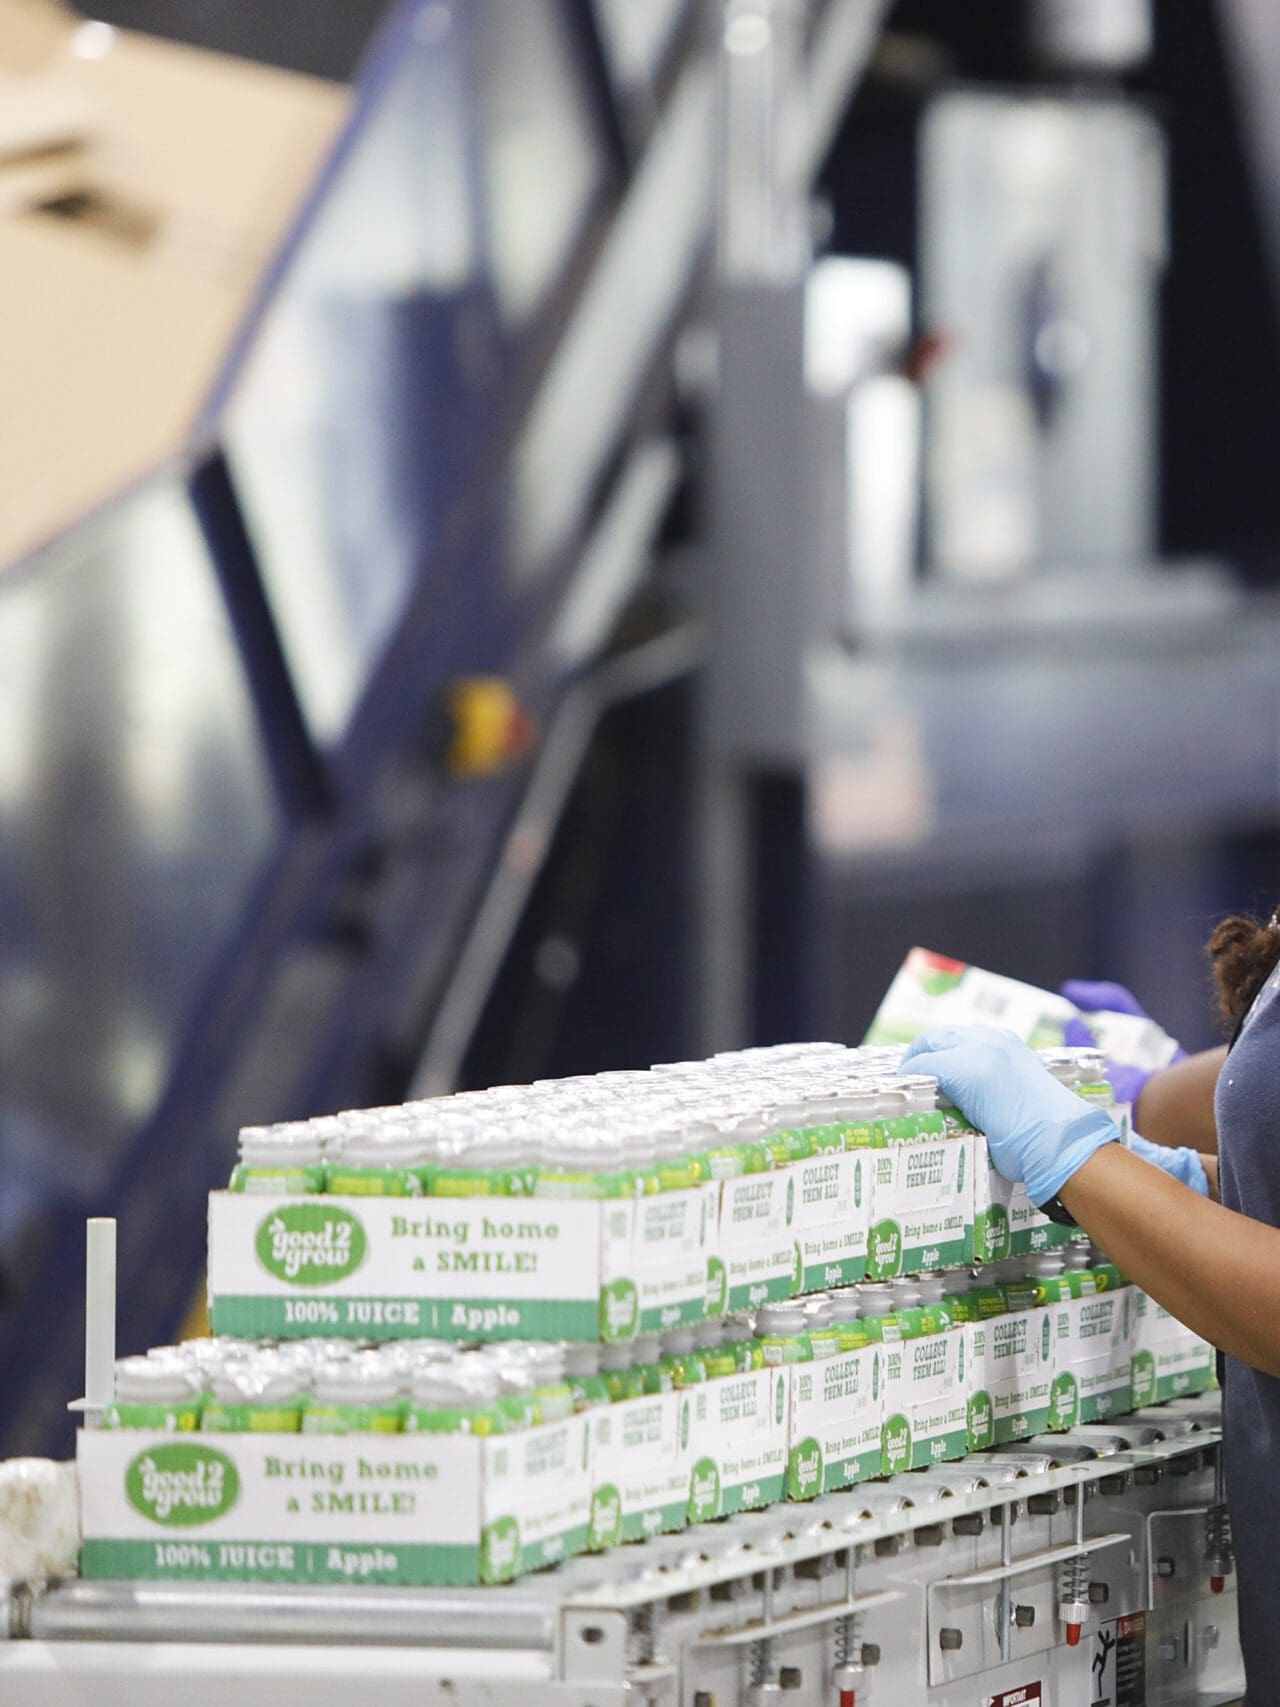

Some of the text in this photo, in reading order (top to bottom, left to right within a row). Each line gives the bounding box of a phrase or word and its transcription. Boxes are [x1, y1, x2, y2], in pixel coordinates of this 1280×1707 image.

[908, 1149, 945, 1170] COLLECT
[803, 1163, 839, 1186] COLLECT
[906, 1173, 926, 1188] THEM
[802, 1188, 822, 1204] THEM
[272, 1221, 352, 1261] good2
[392, 1216, 559, 1244] Bring home
[284, 1246, 350, 1277] grow
[413, 1251, 538, 1273] a SMILE!
[922, 1248, 940, 1266] Apple
[824, 1264, 842, 1284] Apple
[285, 1302, 520, 1331] 100% JUICE Apple
[994, 1319, 1027, 1341] COLLECT
[915, 1339, 948, 1362] COLLECT
[824, 1358, 860, 1384] COLLECT
[913, 1363, 931, 1381] THEM
[824, 1384, 842, 1402] THEM
[930, 1438, 946, 1458] Apple
[265, 1456, 437, 1485] Bring home
[287, 1491, 415, 1514] a SMILE!
[156, 1544, 397, 1576] 100% JUICE Apple
